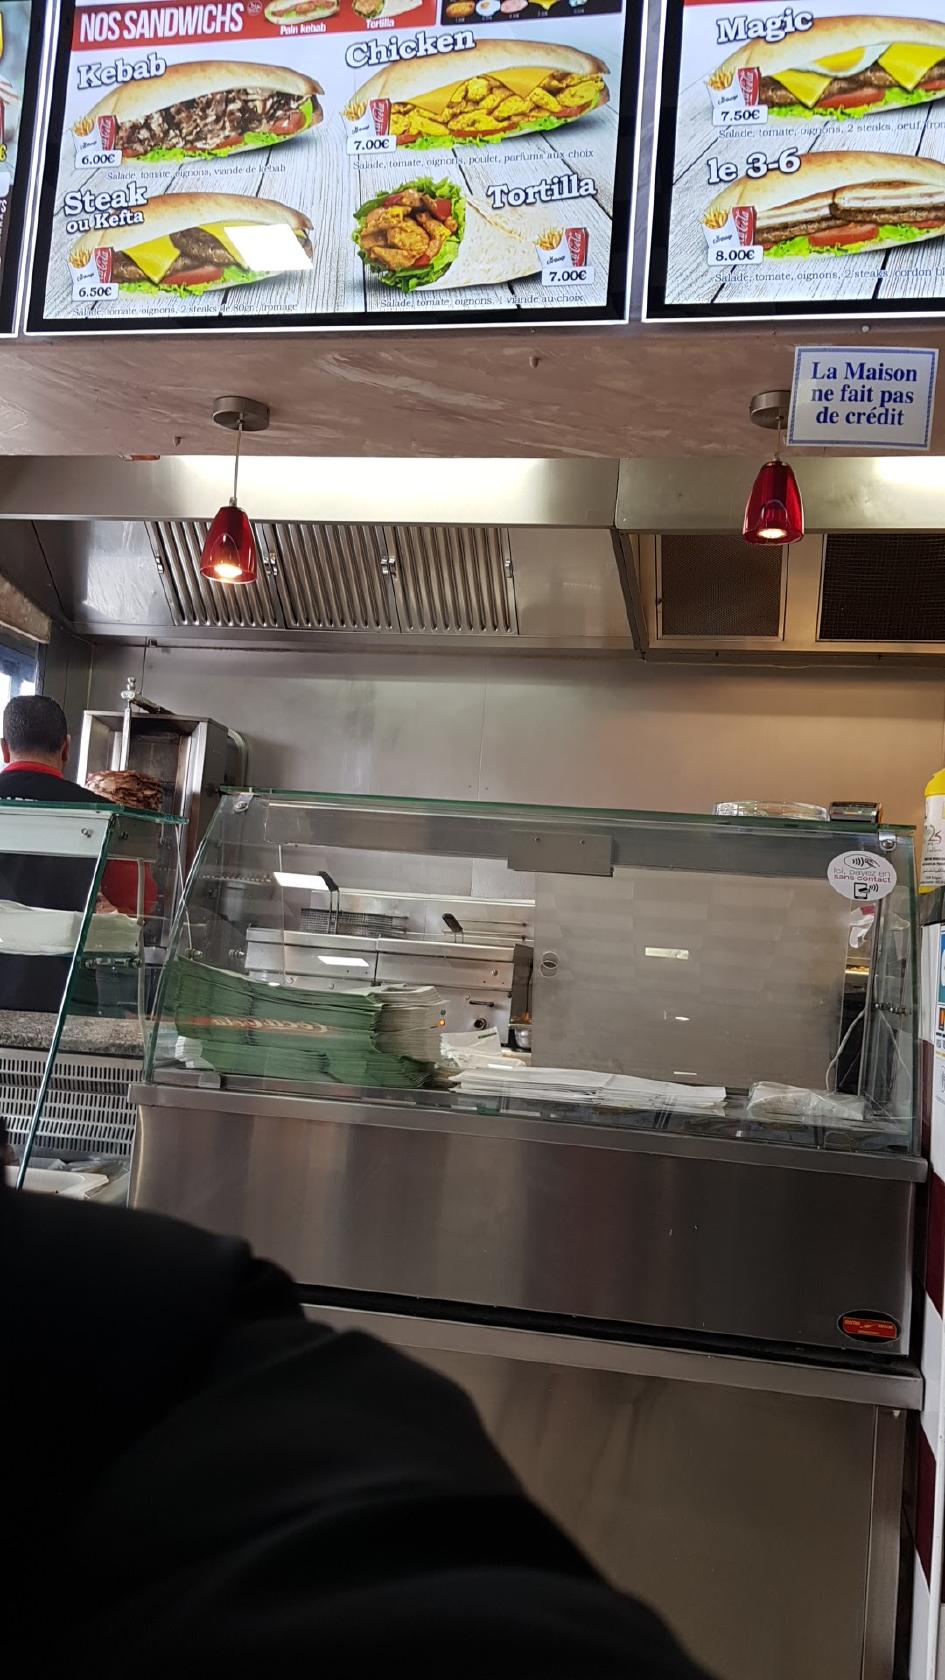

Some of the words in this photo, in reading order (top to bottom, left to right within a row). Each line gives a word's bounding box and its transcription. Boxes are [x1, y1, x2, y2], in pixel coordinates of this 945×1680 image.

[80, 12, 120, 43] NOS
[123, 3, 244, 40] SANDWICHS
[280, 25, 298, 36] Pain
[300, 22, 327, 34] kebab
[366, 17, 395, 29] Tortilla
[716, 8, 814, 45] Magic
[345, 29, 476, 69] Chicken
[77, 53, 167, 90] Kebab
[721, 109, 760, 122] 7.50€
[847, 123, 854, 133] 2
[353, 139, 390, 151] 7.00€
[81, 153, 115, 165] 6.00€
[568, 149, 594, 159] choix
[245, 164, 256, 173] de
[707, 156, 738, 185] le
[746, 147, 801, 179] 3-6
[486, 172, 598, 209] Tortilla
[63, 181, 149, 217] Steak
[66, 217, 90, 235] ou
[92, 208, 145, 231] Kefta
[715, 249, 755, 261] 8.00€
[549, 270, 587, 282] 7.00€
[756, 272, 794, 281] tomate,
[845, 270, 852, 279] 2
[895, 268, 931, 277] cordon
[79, 287, 112, 298] 6.50€
[507, 295, 539, 304] viande
[556, 293, 584, 302] choix
[180, 304, 187, 313] 2
[811, 361, 837, 380] La
[844, 361, 918, 382] Maison
[811, 387, 834, 402] ne
[840, 384, 874, 403] fait
[879, 389, 914, 408] pas
[816, 406, 839, 425] de
[845, 407, 905, 426] crédit
